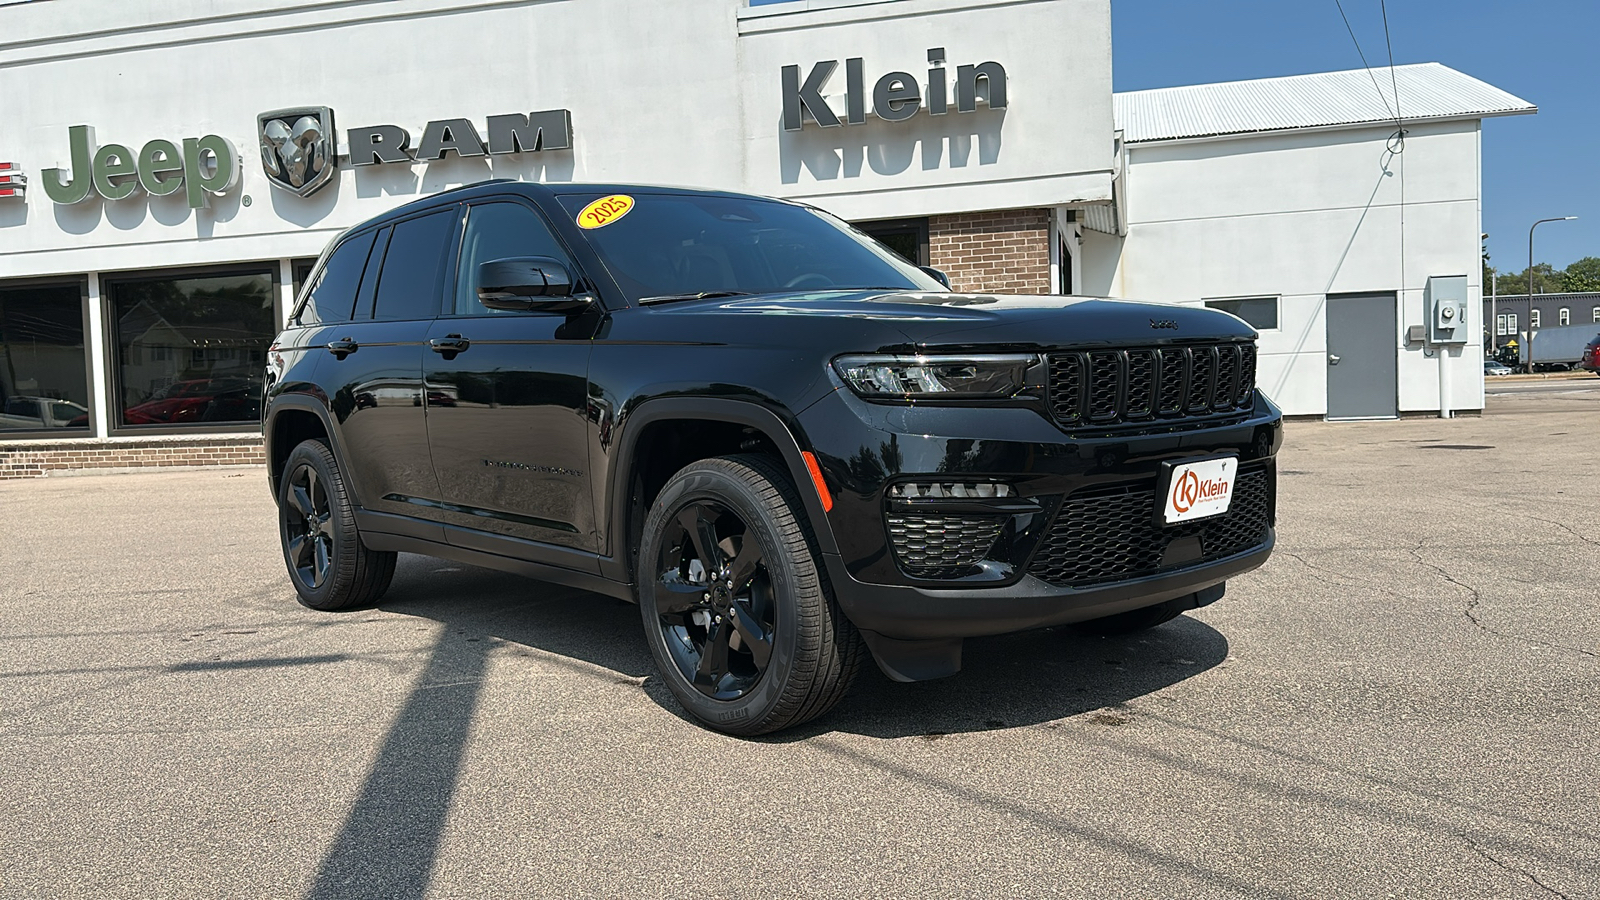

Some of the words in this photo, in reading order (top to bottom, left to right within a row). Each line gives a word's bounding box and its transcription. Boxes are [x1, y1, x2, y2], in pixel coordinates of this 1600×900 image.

[781, 47, 1008, 131] Klein
[347, 109, 572, 166] RAM
[41, 125, 238, 209] Jeep
[586, 197, 628, 224] 2025
[1199, 477, 1228, 499] Klein
